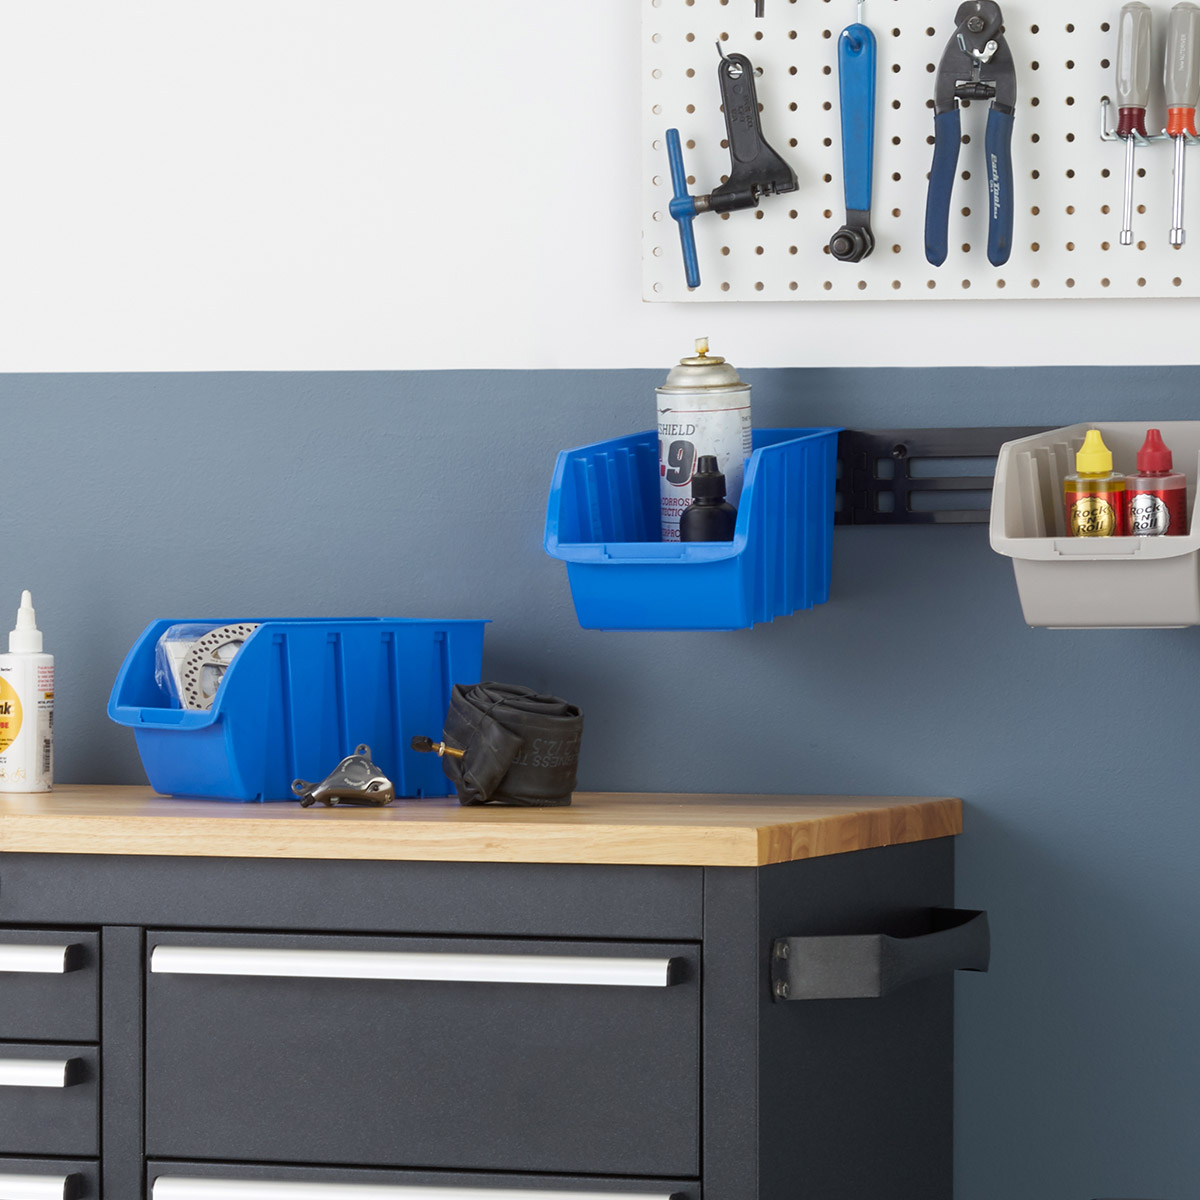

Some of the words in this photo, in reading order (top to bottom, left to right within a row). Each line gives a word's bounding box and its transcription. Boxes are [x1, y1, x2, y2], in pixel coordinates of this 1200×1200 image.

[1073, 506, 1107, 518] Rock
[1131, 503, 1161, 515] Rock
[1087, 516, 1097, 524] N
[1133, 518, 1158, 530] Roll
[1077, 521, 1104, 533] Roll
